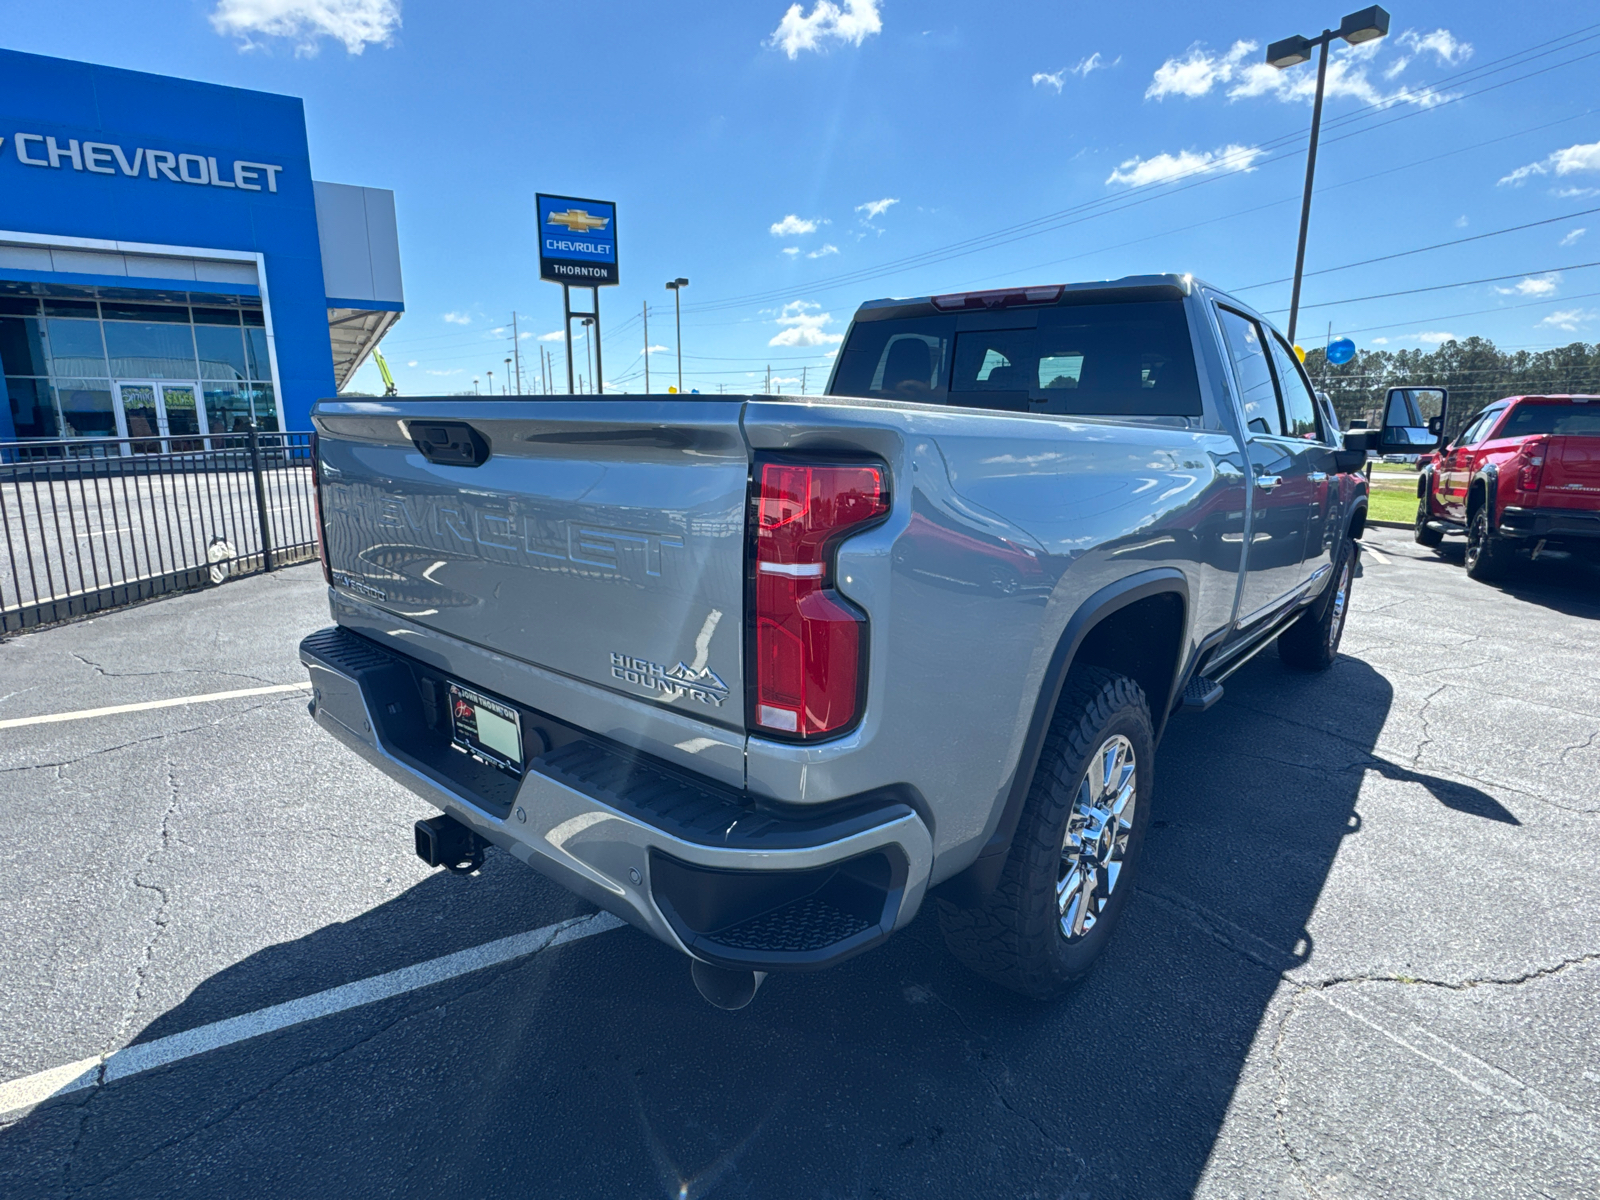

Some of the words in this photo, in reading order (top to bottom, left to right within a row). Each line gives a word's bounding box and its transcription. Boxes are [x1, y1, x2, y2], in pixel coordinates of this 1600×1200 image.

[14, 132, 283, 193] CHEVROLET
[546, 239, 611, 254] CHEVROLET
[553, 264, 608, 277] THORNTON
[334, 486, 684, 577] CHEVROLET
[610, 652, 666, 678] HIGH
[611, 665, 729, 707] COUNTRY
[461, 689, 479, 704] JOHN
[478, 696, 515, 721] THORNTON
